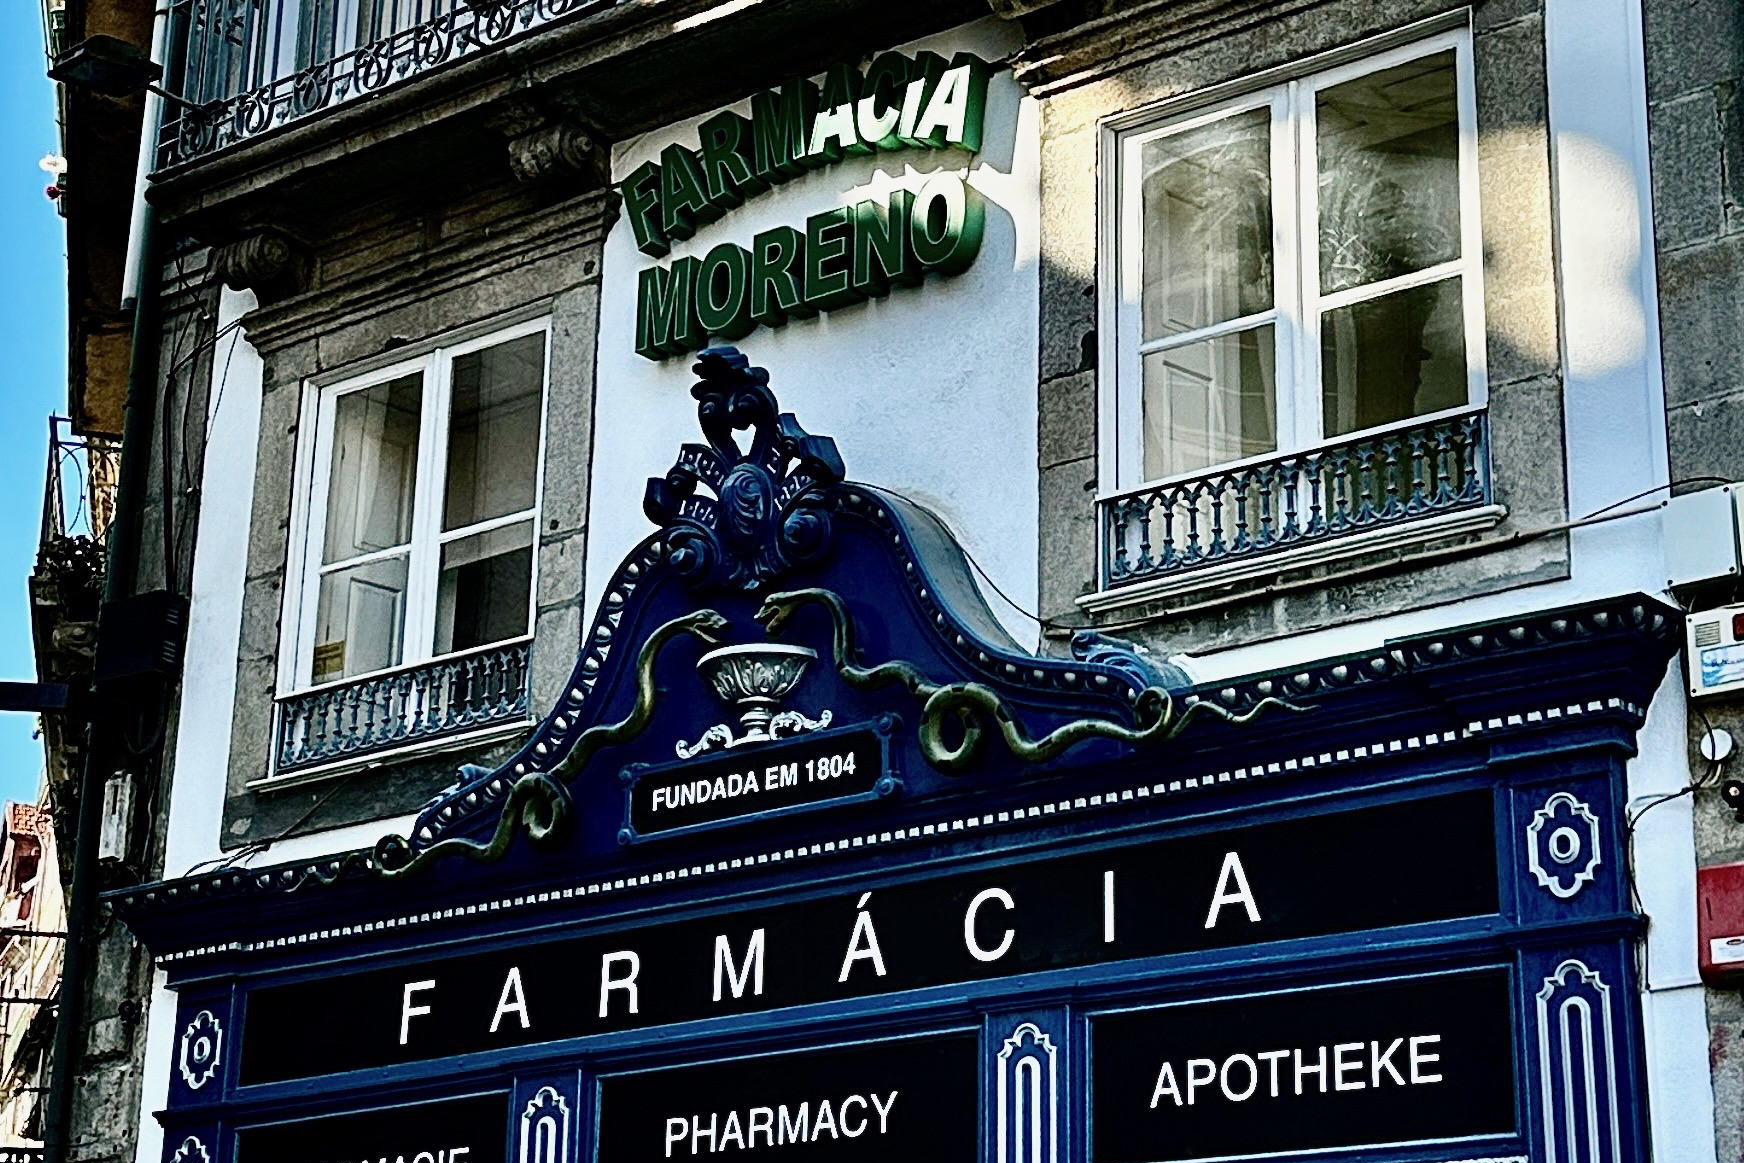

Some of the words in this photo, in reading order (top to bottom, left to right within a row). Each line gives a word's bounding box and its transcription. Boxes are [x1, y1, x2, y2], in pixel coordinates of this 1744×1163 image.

[620, 52, 988, 258] FARMACIA
[635, 168, 985, 360] MORENO
[652, 771, 759, 812] FUNDADA
[765, 763, 798, 790] EM
[805, 752, 856, 782] 1804
[400, 851, 1262, 1045] FARMÁCIA
[665, 1090, 899, 1158] PHARMACY
[1150, 1034, 1443, 1109] APOTHEKE
